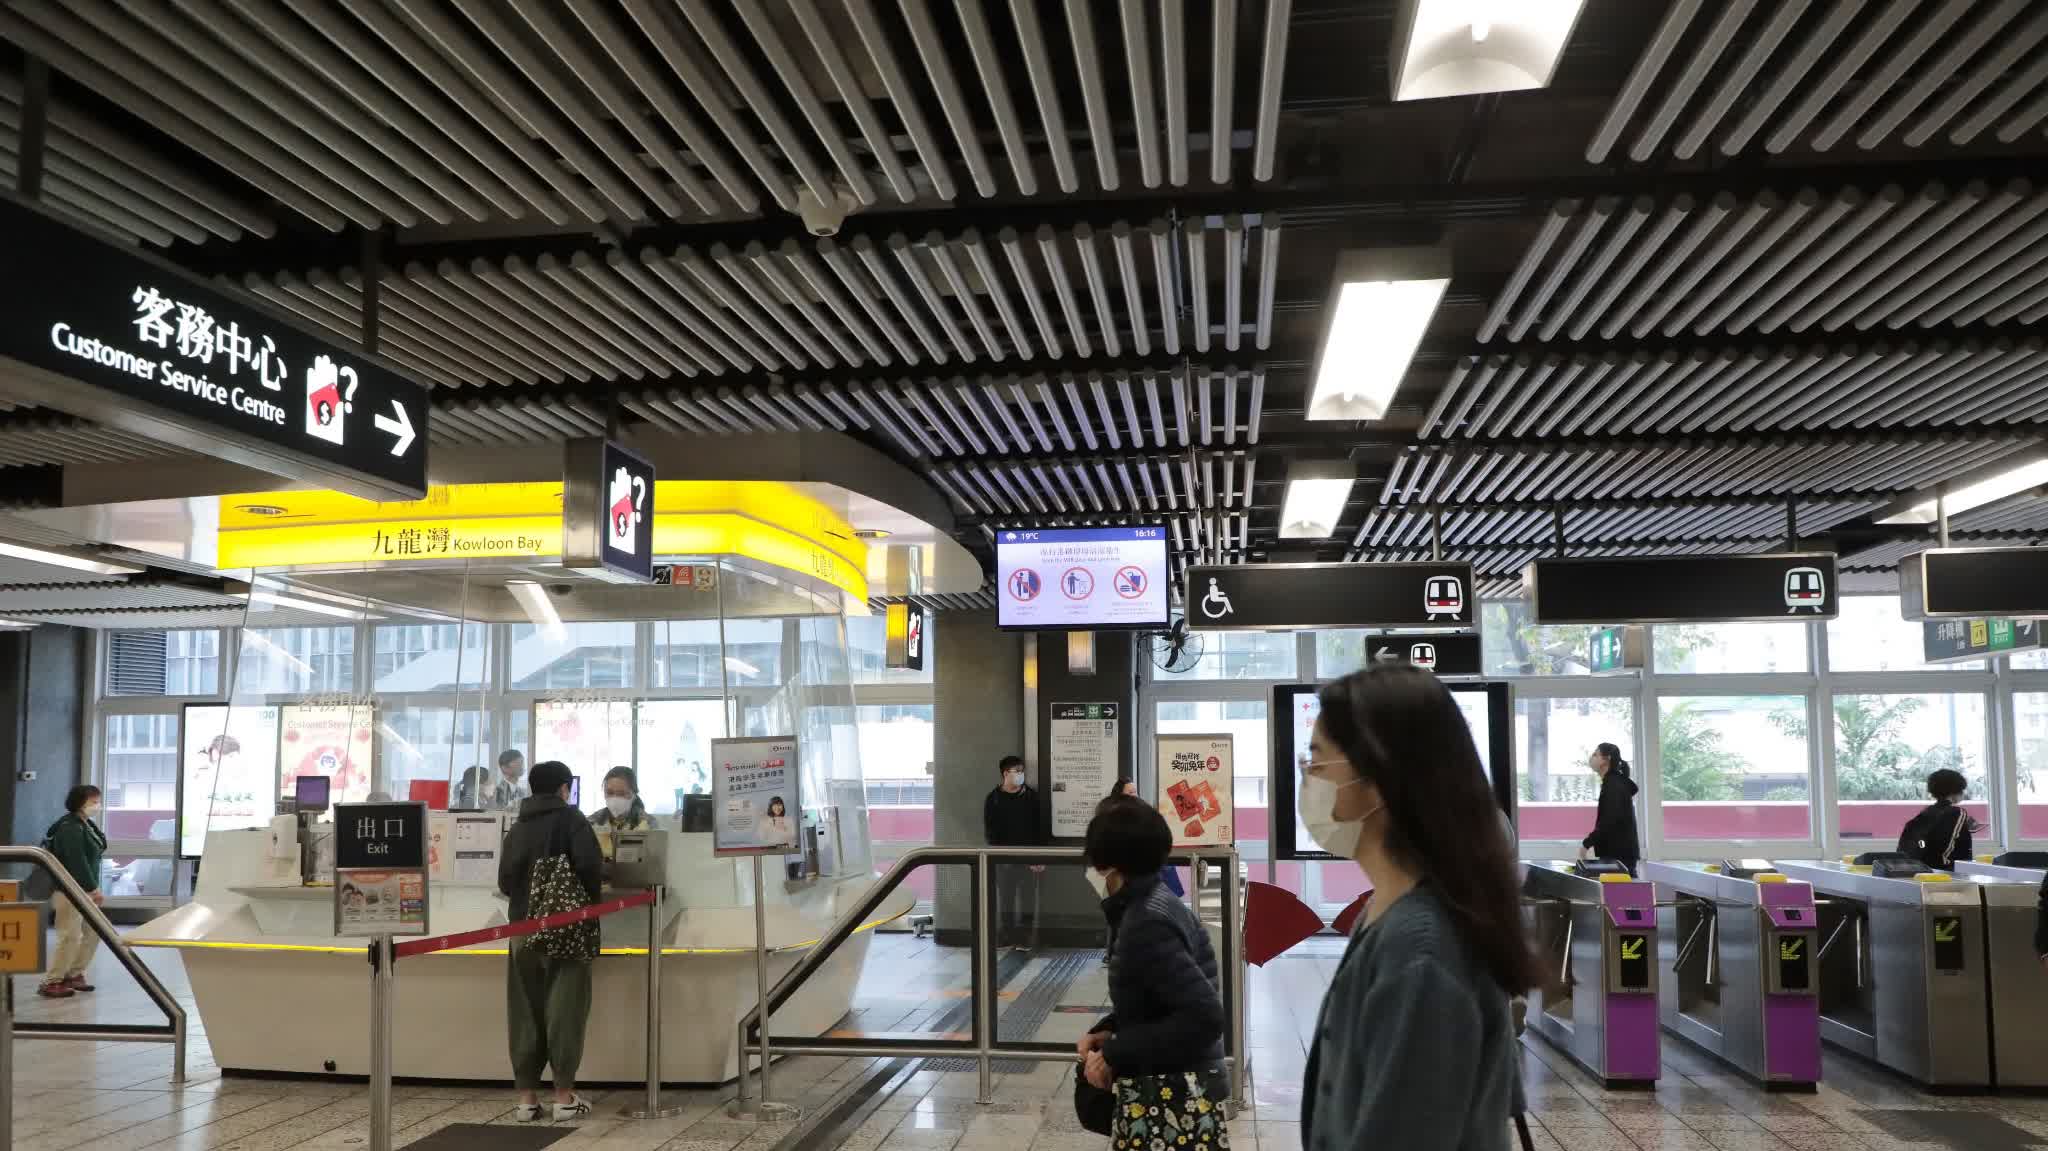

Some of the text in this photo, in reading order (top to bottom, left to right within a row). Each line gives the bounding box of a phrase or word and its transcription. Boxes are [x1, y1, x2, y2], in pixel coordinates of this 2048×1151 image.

[132, 286, 288, 392] 客務中心
[51, 322, 286, 425] Customer Service Centre
[371, 527, 450, 555] 九龍灣
[454, 536, 542, 551] Kowloon Bay
[1135, 529, 1156, 538] 16:16
[357, 816, 403, 839] 出口
[367, 842, 389, 854] Exit
